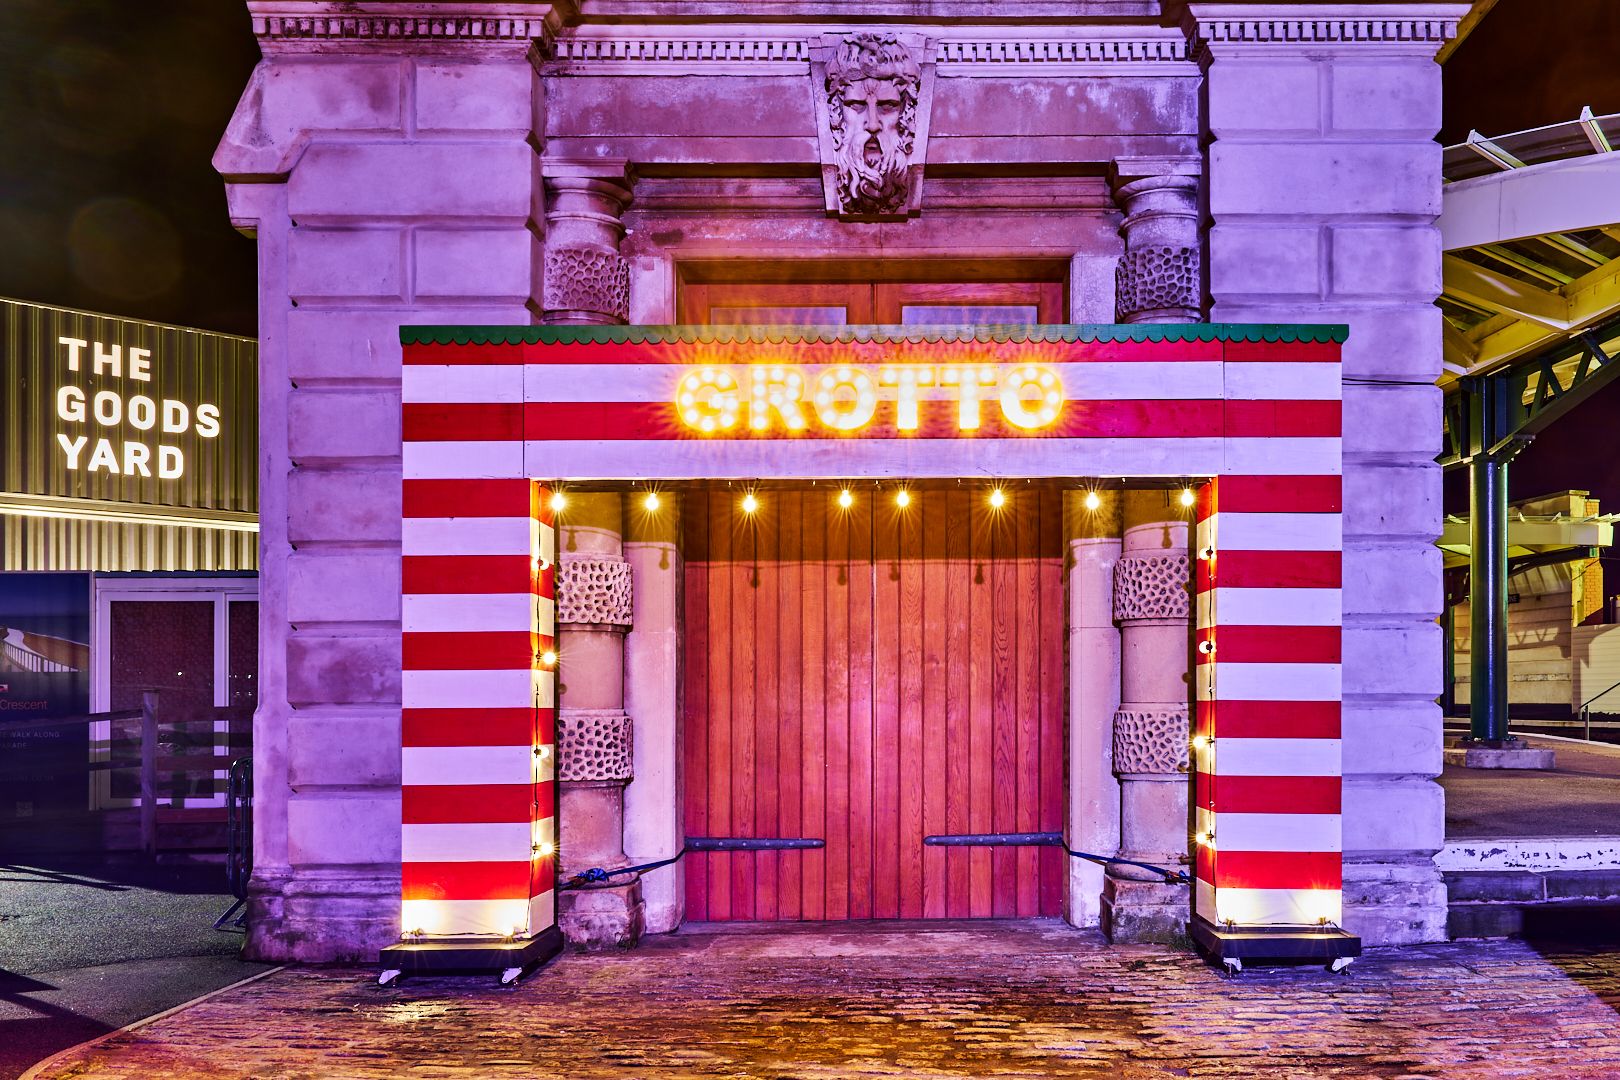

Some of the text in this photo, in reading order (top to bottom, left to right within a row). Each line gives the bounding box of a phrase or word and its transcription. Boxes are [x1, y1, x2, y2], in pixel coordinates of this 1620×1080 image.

[58, 336, 151, 382] THE
[57, 385, 220, 438] GOODS
[675, 363, 1064, 431] GROTTO
[56, 433, 184, 479] YARD
[0, 699, 48, 711] Crescent
